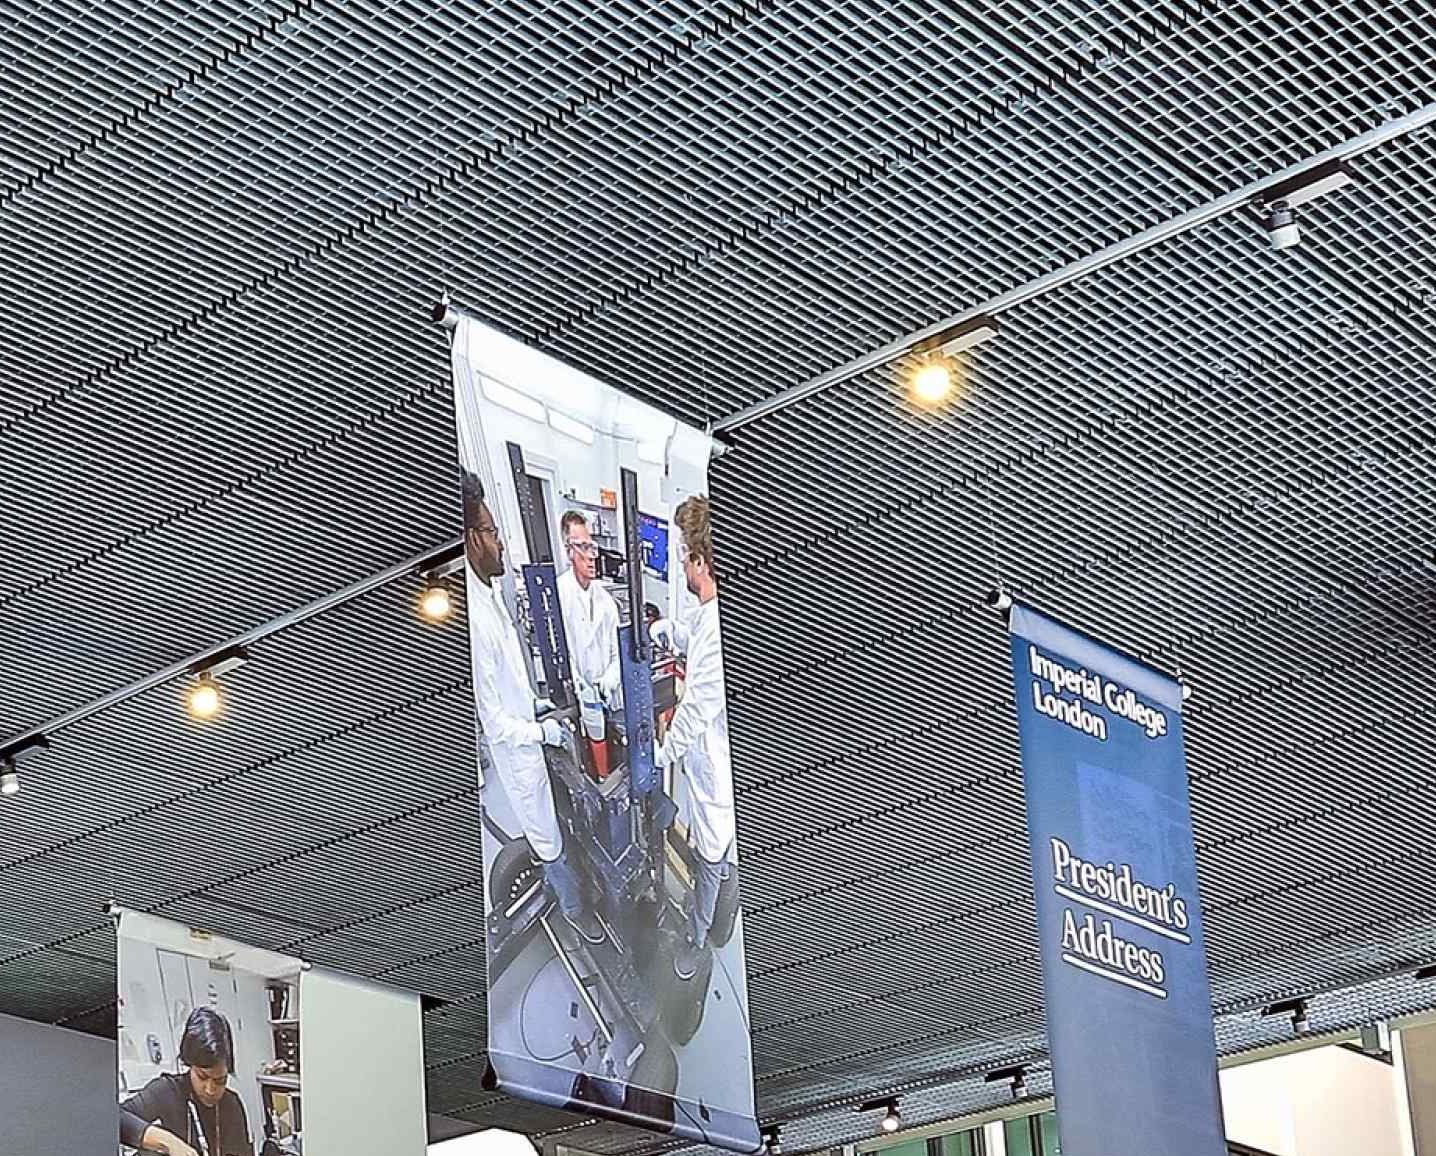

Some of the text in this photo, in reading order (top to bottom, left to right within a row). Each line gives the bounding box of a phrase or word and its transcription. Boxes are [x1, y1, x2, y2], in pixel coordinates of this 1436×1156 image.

[1029, 645, 1168, 738] Imperial College
[1033, 682, 1108, 741] London
[1051, 837, 1188, 931] President's
[1061, 909, 1165, 984] Address
